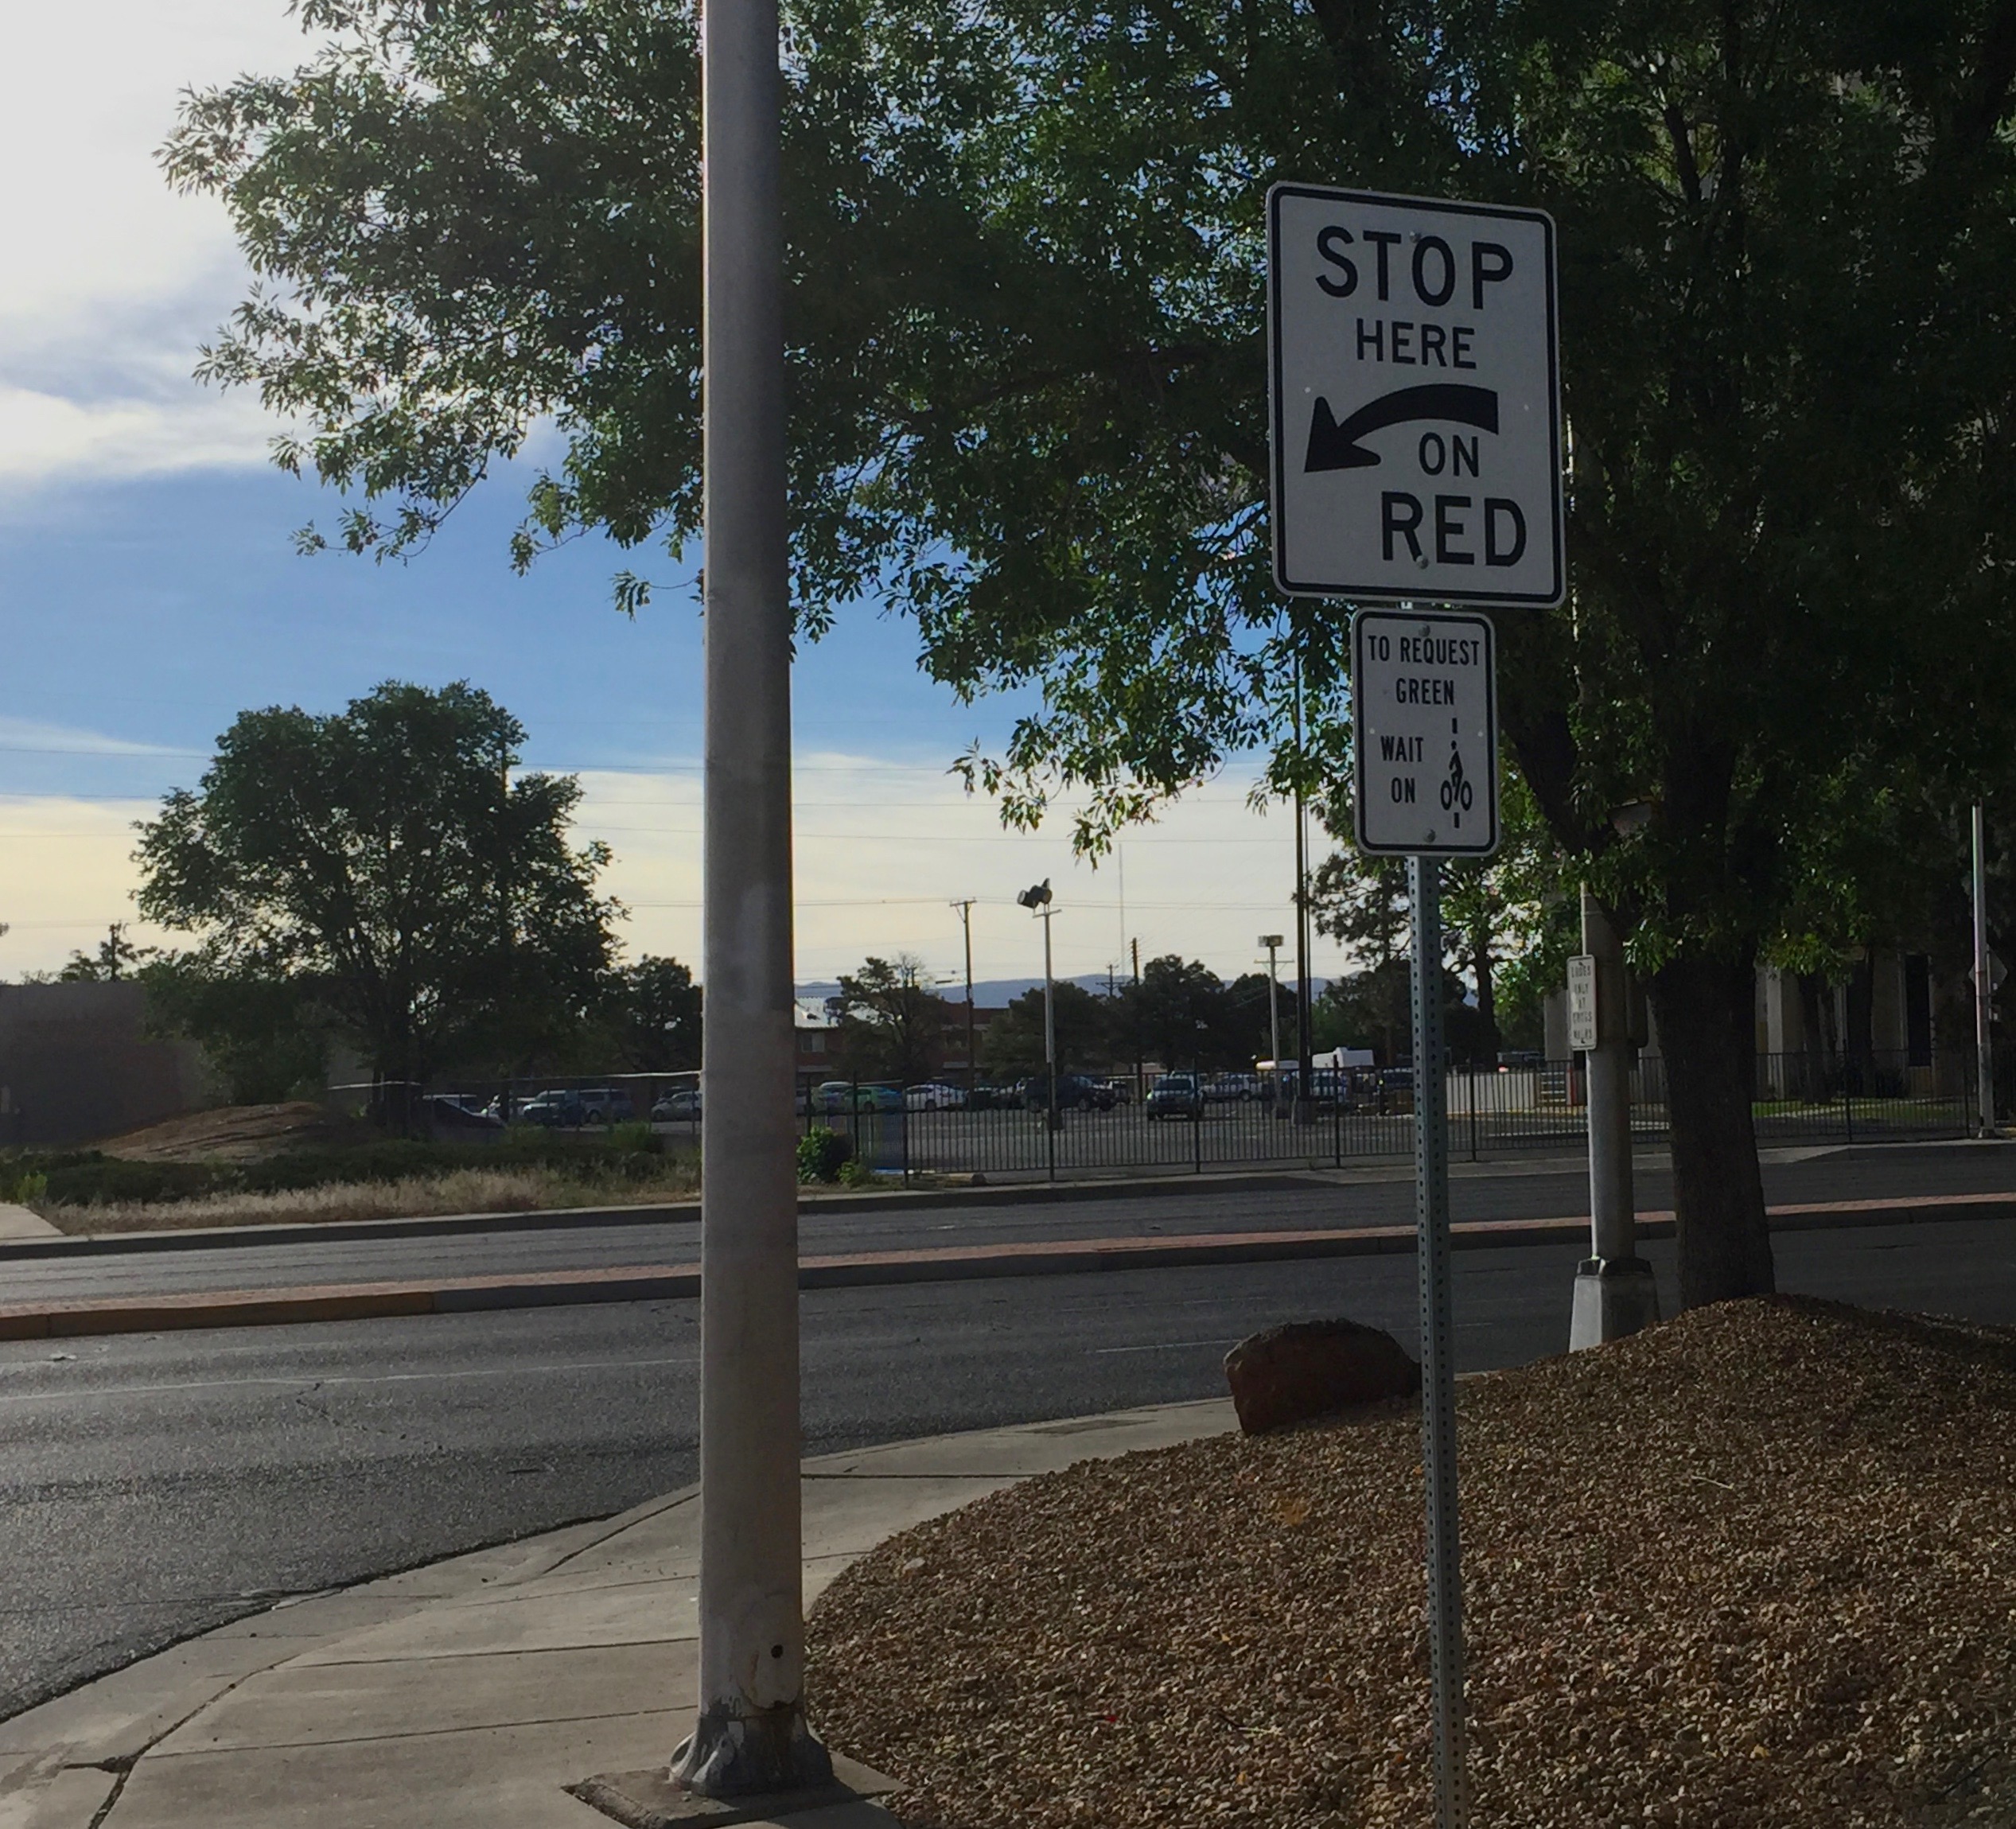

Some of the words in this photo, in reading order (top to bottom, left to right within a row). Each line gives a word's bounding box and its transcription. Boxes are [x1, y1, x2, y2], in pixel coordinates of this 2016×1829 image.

[1315, 225, 1513, 309] STOP
[1356, 317, 1477, 369] HERE
[1419, 432, 1479, 477] ON
[1382, 491, 1527, 566] RED
[1368, 636, 1390, 662] TO
[1400, 636, 1480, 666] REQUEST
[1396, 678, 1454, 706] GREEN
[1381, 736, 1423, 762] WAIT
[1391, 777, 1415, 804] ON
